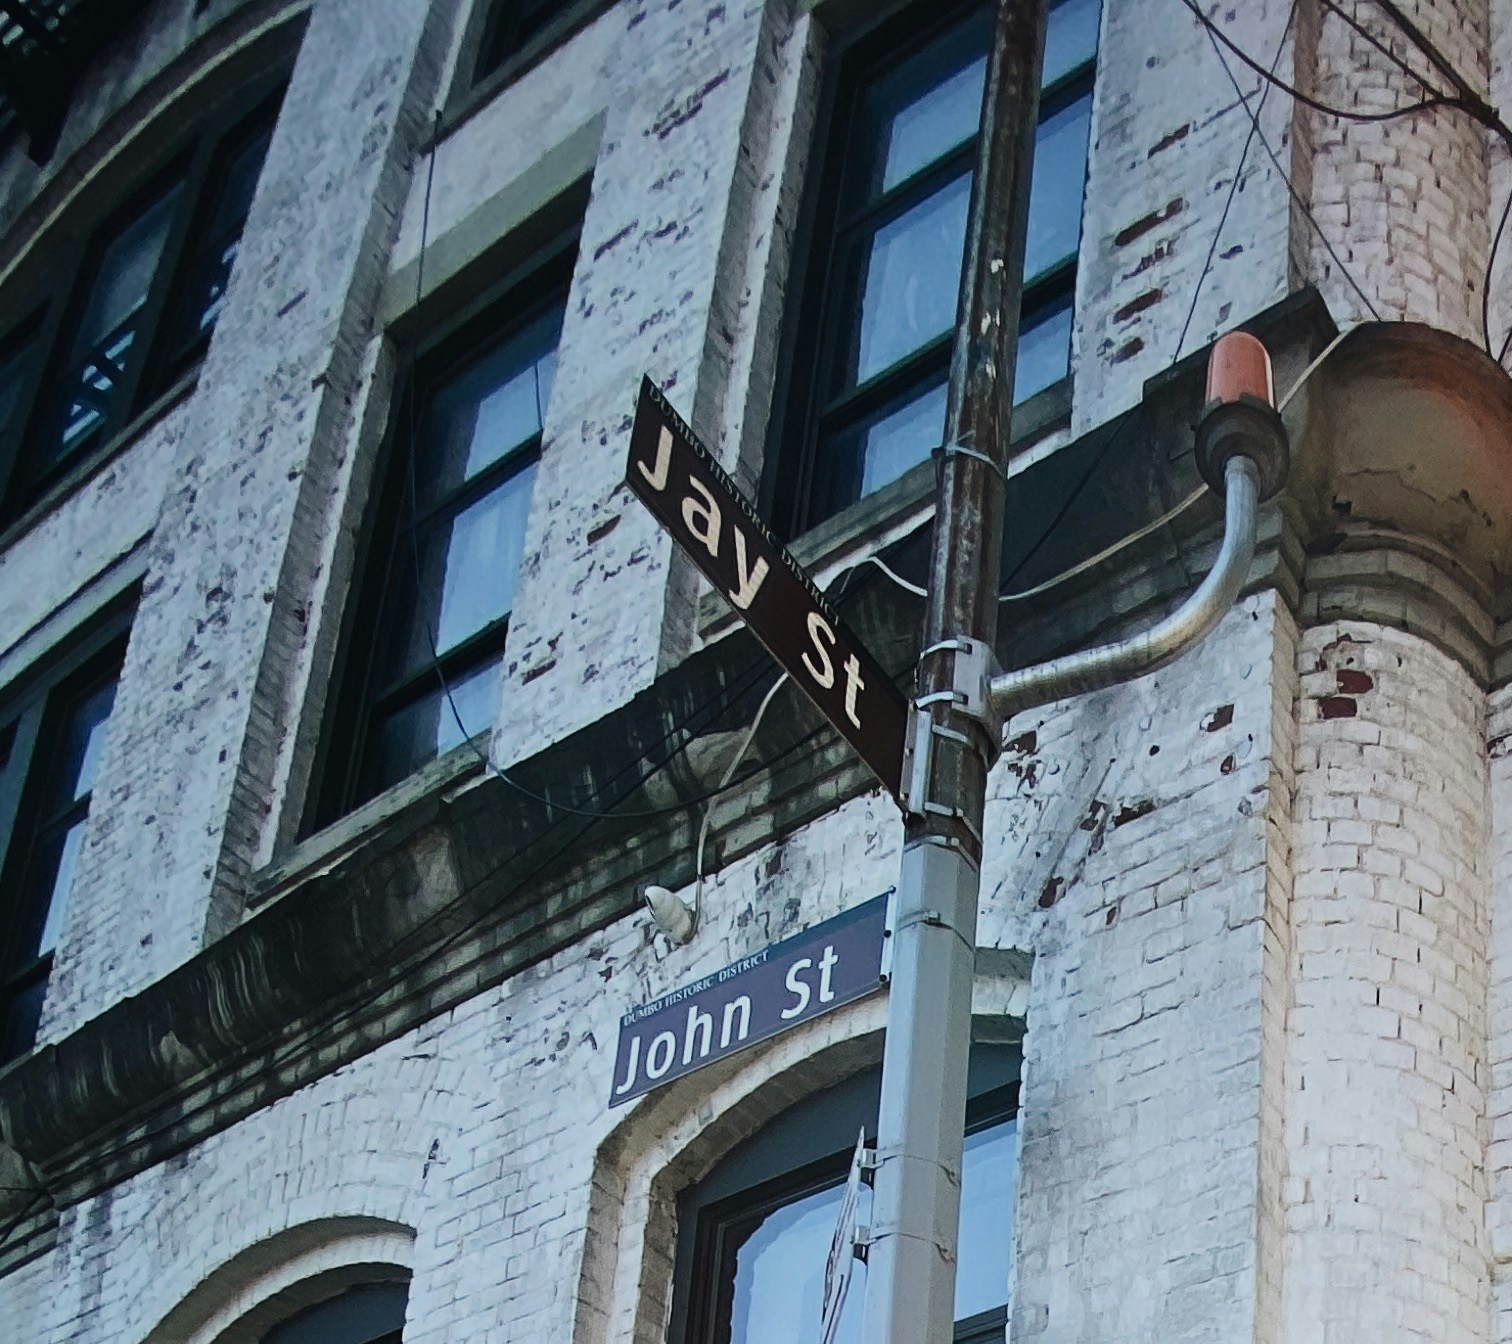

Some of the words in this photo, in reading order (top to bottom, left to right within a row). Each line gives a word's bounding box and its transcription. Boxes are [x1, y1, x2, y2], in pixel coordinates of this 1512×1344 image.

[638, 424, 770, 610] Jay
[801, 611, 865, 730] St
[649, 382, 706, 459] DUMBO
[709, 459, 775, 546] HISTORIC
[781, 547, 839, 626] DISTRICT
[616, 995, 751, 1095] John
[780, 945, 838, 1020] St
[624, 1001, 662, 1026] DUMBO
[665, 978, 713, 1008] HISTORIC
[718, 949, 769, 982] DISTRICT
